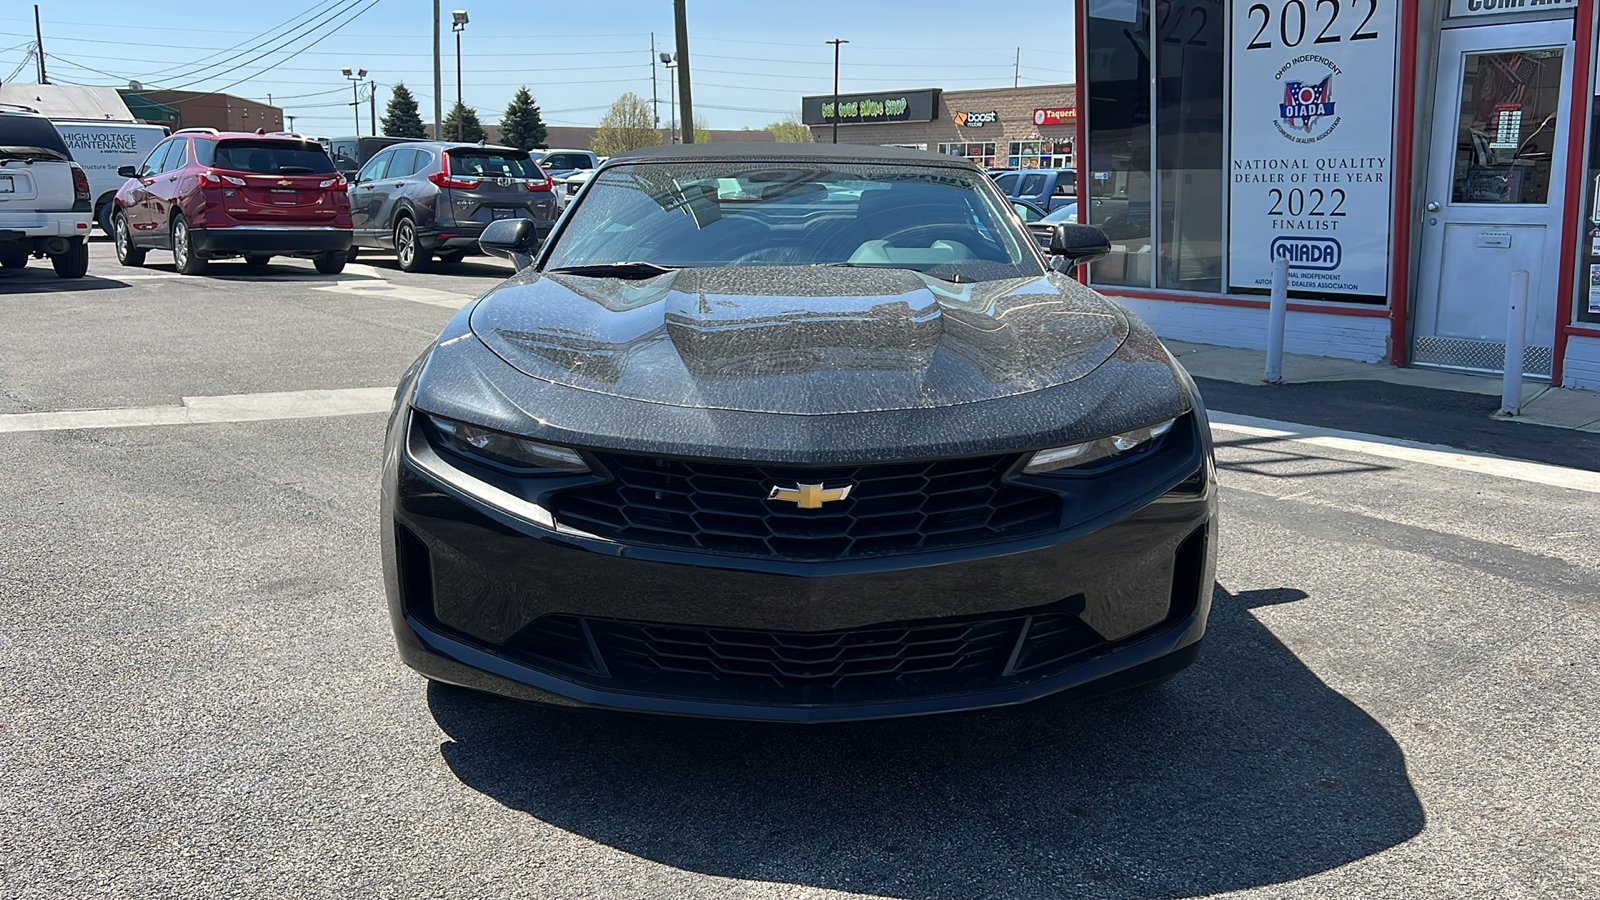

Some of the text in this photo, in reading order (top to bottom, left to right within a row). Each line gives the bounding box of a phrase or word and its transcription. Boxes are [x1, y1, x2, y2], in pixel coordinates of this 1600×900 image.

[1247, 0, 1378, 50] 2022
[1275, 55, 1343, 80] OHIO INDEPENDENT
[1046, 108, 1077, 119] Taqueri
[1286, 104, 1325, 117] OIADA
[967, 111, 996, 122] boost
[1273, 119, 1296, 142] AUTOMOBILE
[1316, 116, 1342, 141] ASSOCIATION
[63, 133, 136, 142] HIGH VOLTAGE
[66, 140, 138, 150] MAINTENANCE
[1233, 158, 1386, 171] NATIONAL QUALITY
[1235, 173, 1384, 183] DEALER OF THE YEAR
[1267, 188, 1347, 217] 2022
[1272, 219, 1339, 230] FINALIST
[1276, 243, 1335, 264] NIADA
[1300, 272, 1341, 281] INDEPENDENT
[1317, 282, 1359, 291] ASSOCIATION
